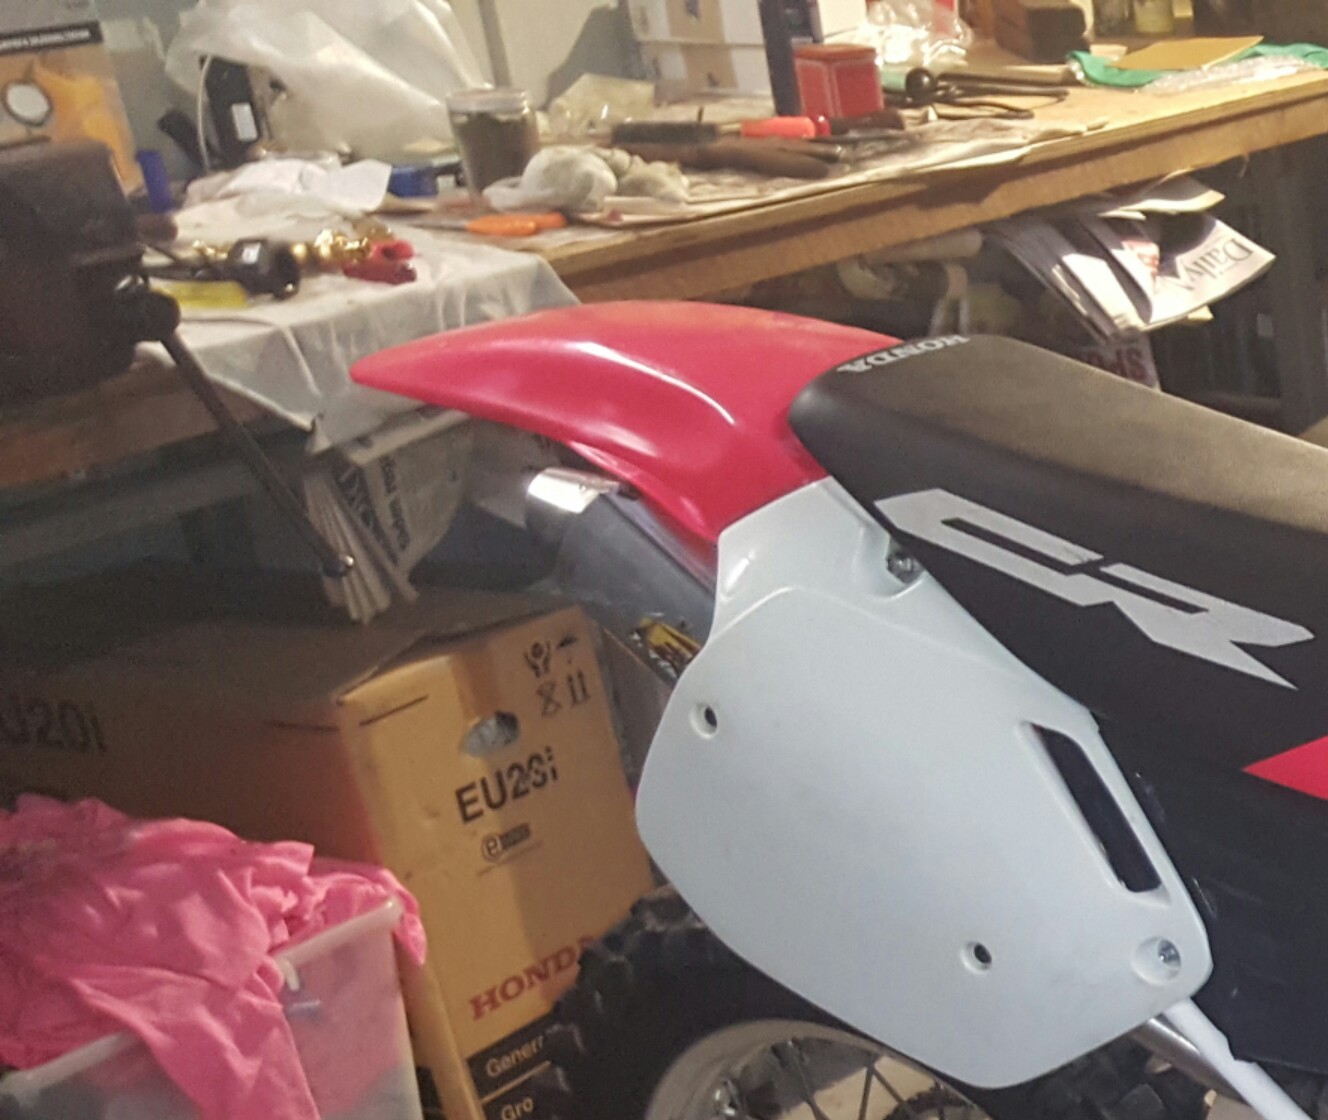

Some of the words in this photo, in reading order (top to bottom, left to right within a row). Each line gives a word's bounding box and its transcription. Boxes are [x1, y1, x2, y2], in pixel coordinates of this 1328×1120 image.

[1183, 238, 1254, 283] Daily
[837, 335, 970, 372] HONDA
[874, 488, 1315, 690] CR
[469, 935, 595, 1022] HOND
